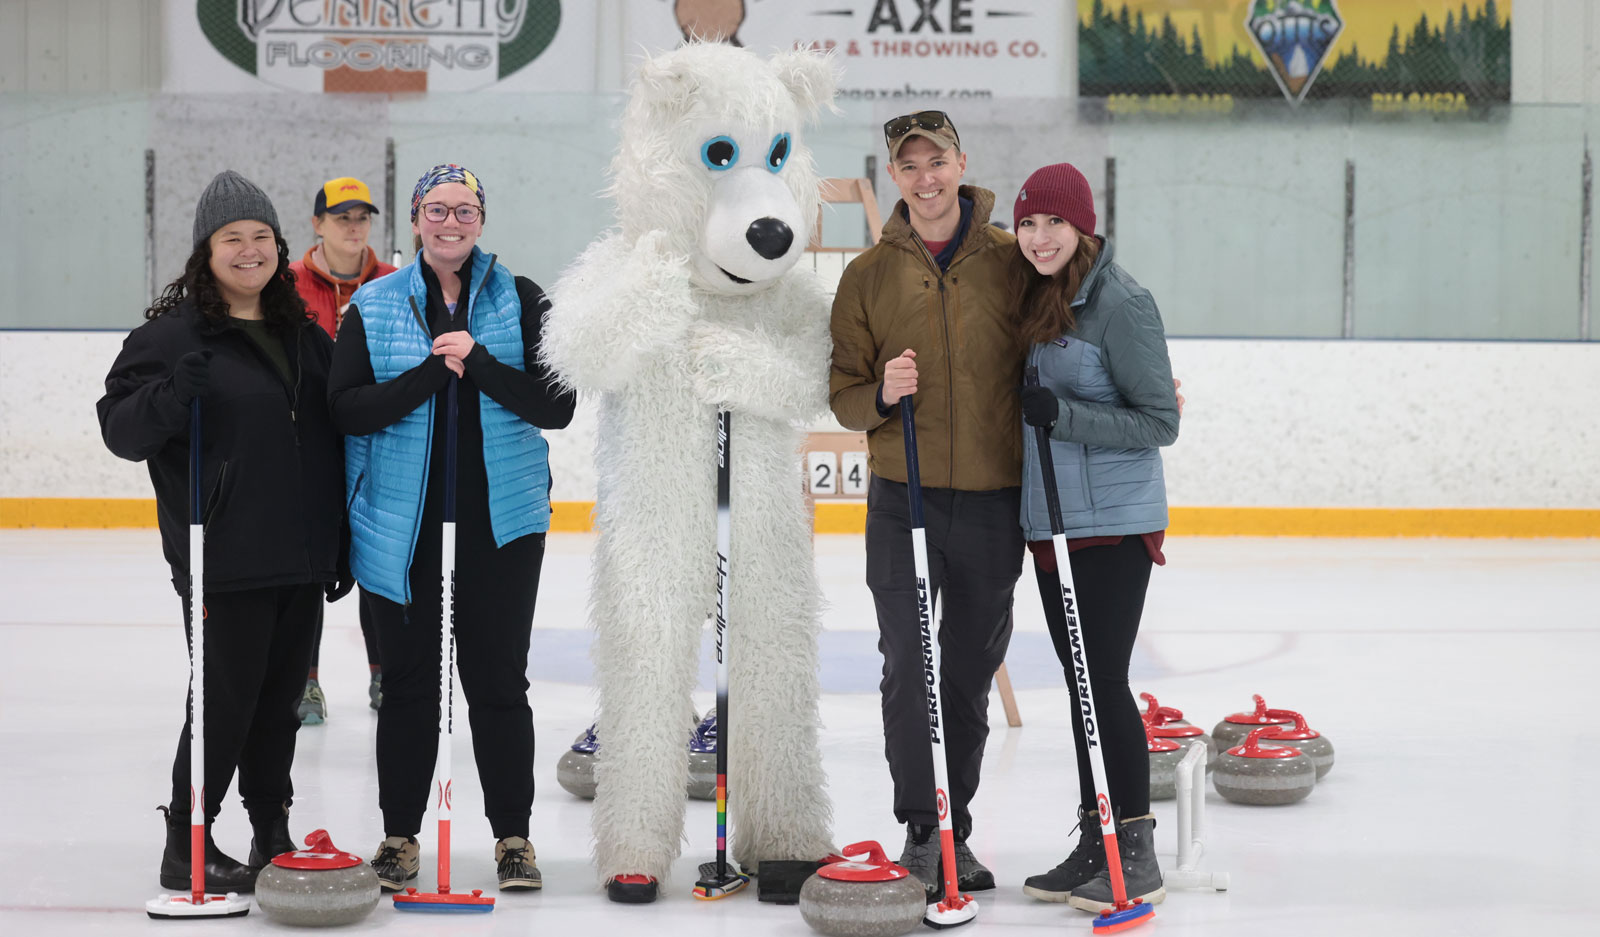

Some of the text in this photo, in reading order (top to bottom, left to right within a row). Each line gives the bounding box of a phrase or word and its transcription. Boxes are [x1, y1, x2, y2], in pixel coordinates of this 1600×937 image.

[793, 39, 1046, 57] AR & THROWING CO.
[867, 0, 974, 34] AXE
[266, 41, 492, 70] FLOORING
[716, 551, 727, 664] Hardline
[916, 576, 941, 744] PERFORMANCE
[1062, 584, 1098, 749] TOURNAMENT
